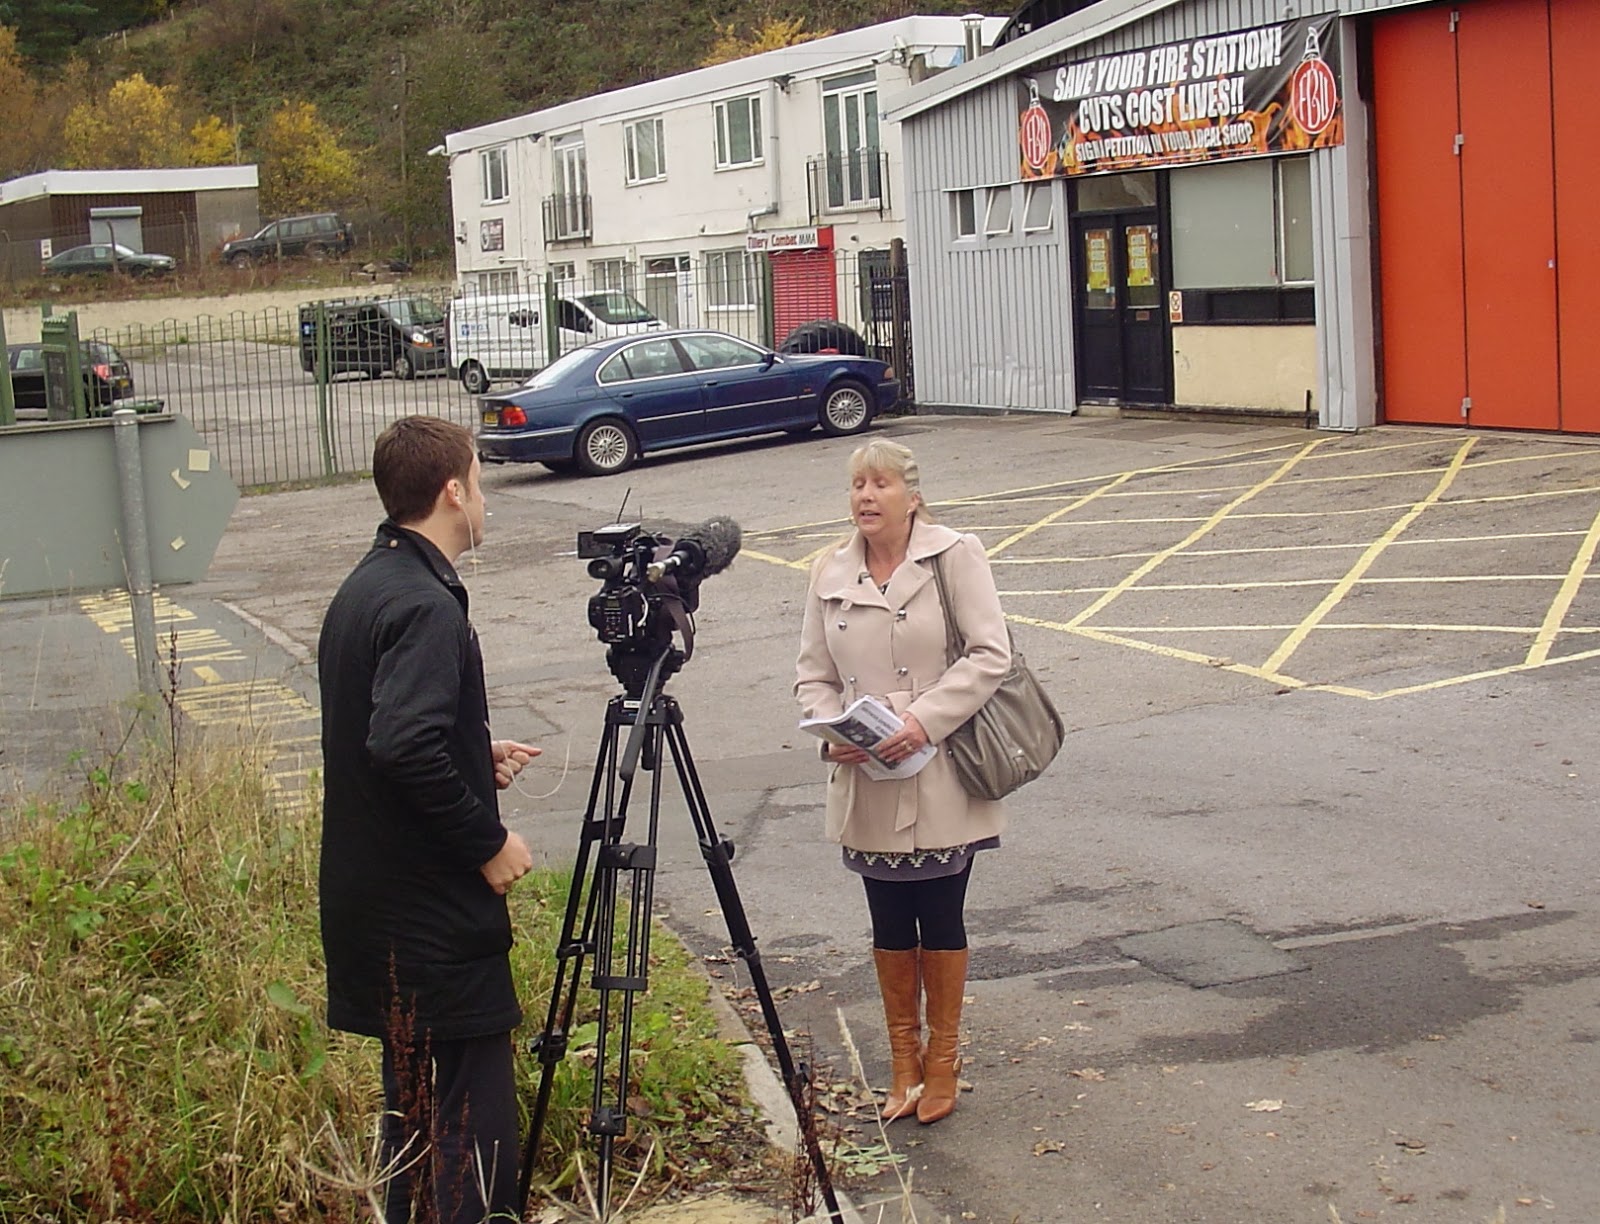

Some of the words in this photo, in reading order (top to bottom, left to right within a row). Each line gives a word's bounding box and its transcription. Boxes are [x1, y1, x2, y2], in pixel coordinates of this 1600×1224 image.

[1053, 62, 1096, 102] SAVE
[1095, 52, 1147, 93] YOUR
[1147, 43, 1191, 86] FIRE
[1191, 27, 1282, 75] STATION!
[1079, 94, 1125, 134] CUTS
[1126, 87, 1176, 128] COST
[1178, 77, 1245, 122] LIVES!!
[1299, 68, 1329, 129] FBU
[1104, 134, 1153, 158] PETITION
[1161, 130, 1192, 152] YOUR
[1190, 126, 1223, 149] LOCAL
[1222, 121, 1254, 146] SHOP
[771, 233, 798, 247] Combat
